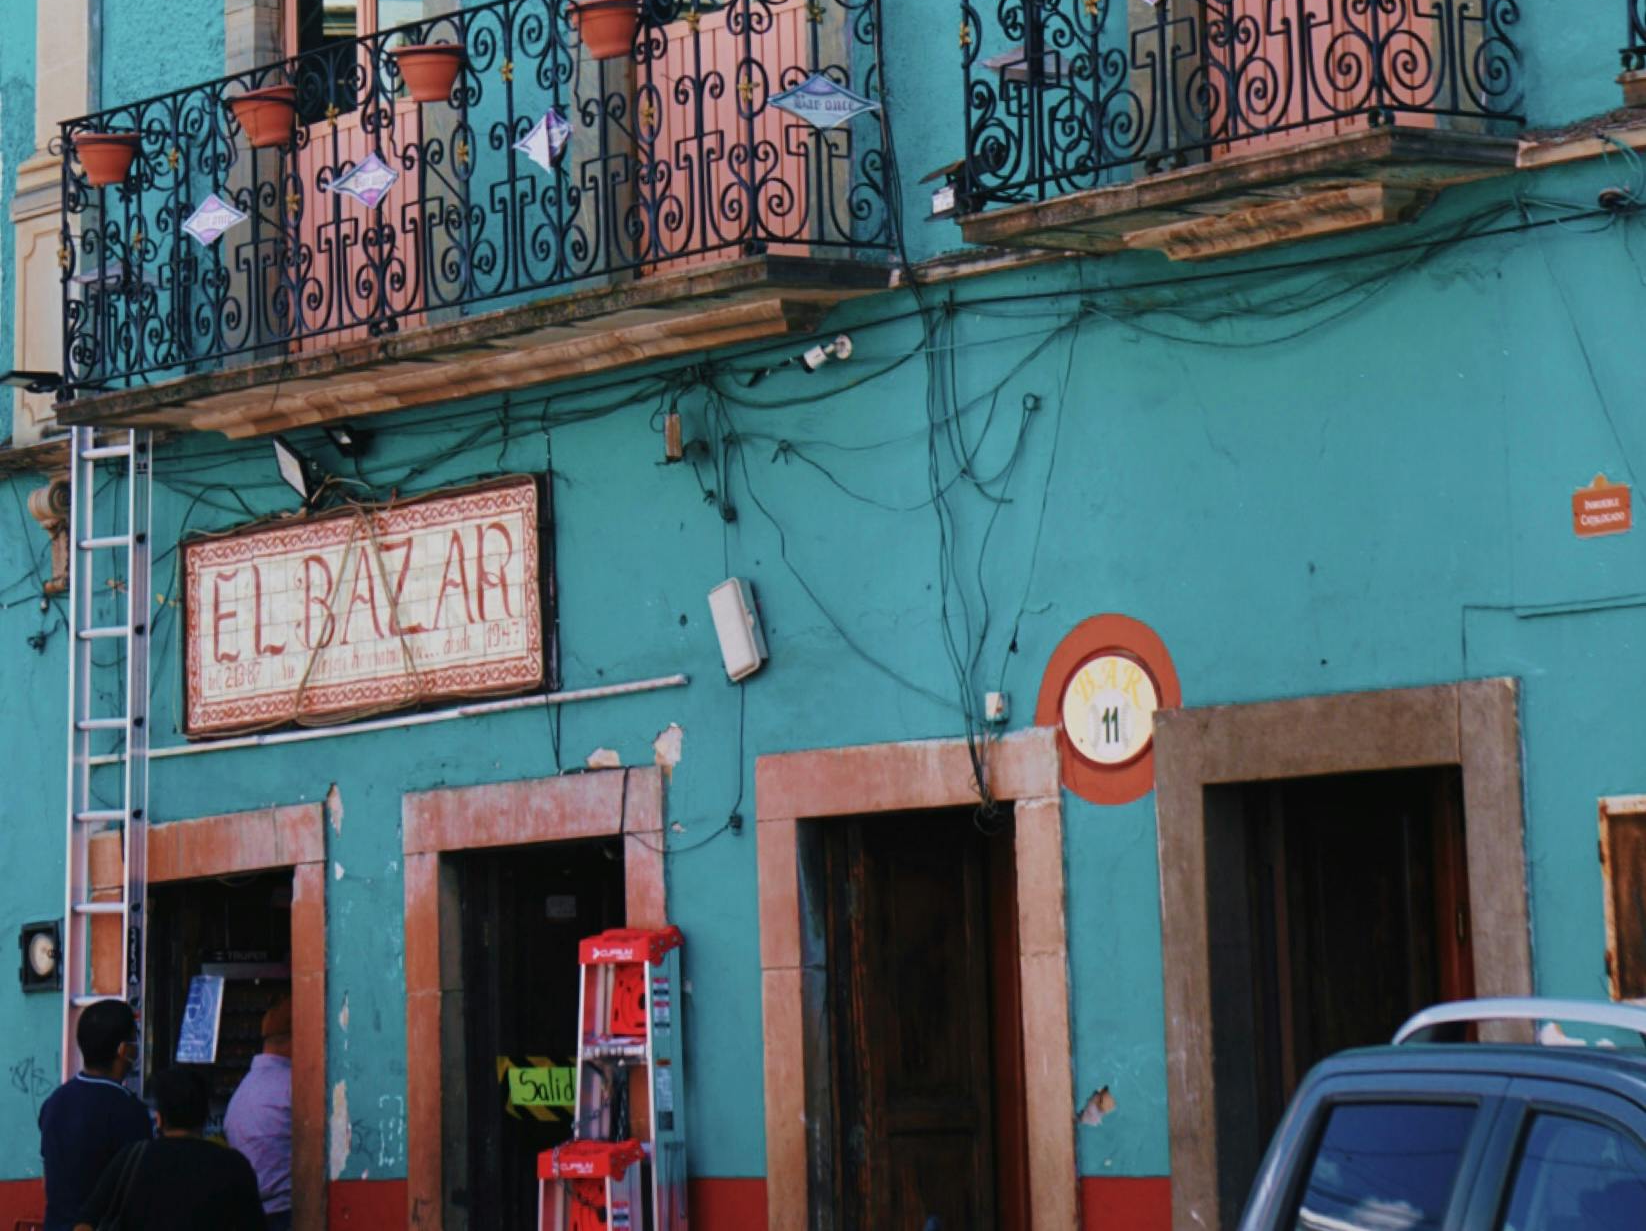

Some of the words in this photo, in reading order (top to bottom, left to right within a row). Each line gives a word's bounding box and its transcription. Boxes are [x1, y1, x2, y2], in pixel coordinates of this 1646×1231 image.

[213, 563, 287, 663] EL
[295, 522, 514, 651] BAZAR
[1102, 706, 1119, 744] 11
[519, 1066, 576, 1103] Salid
